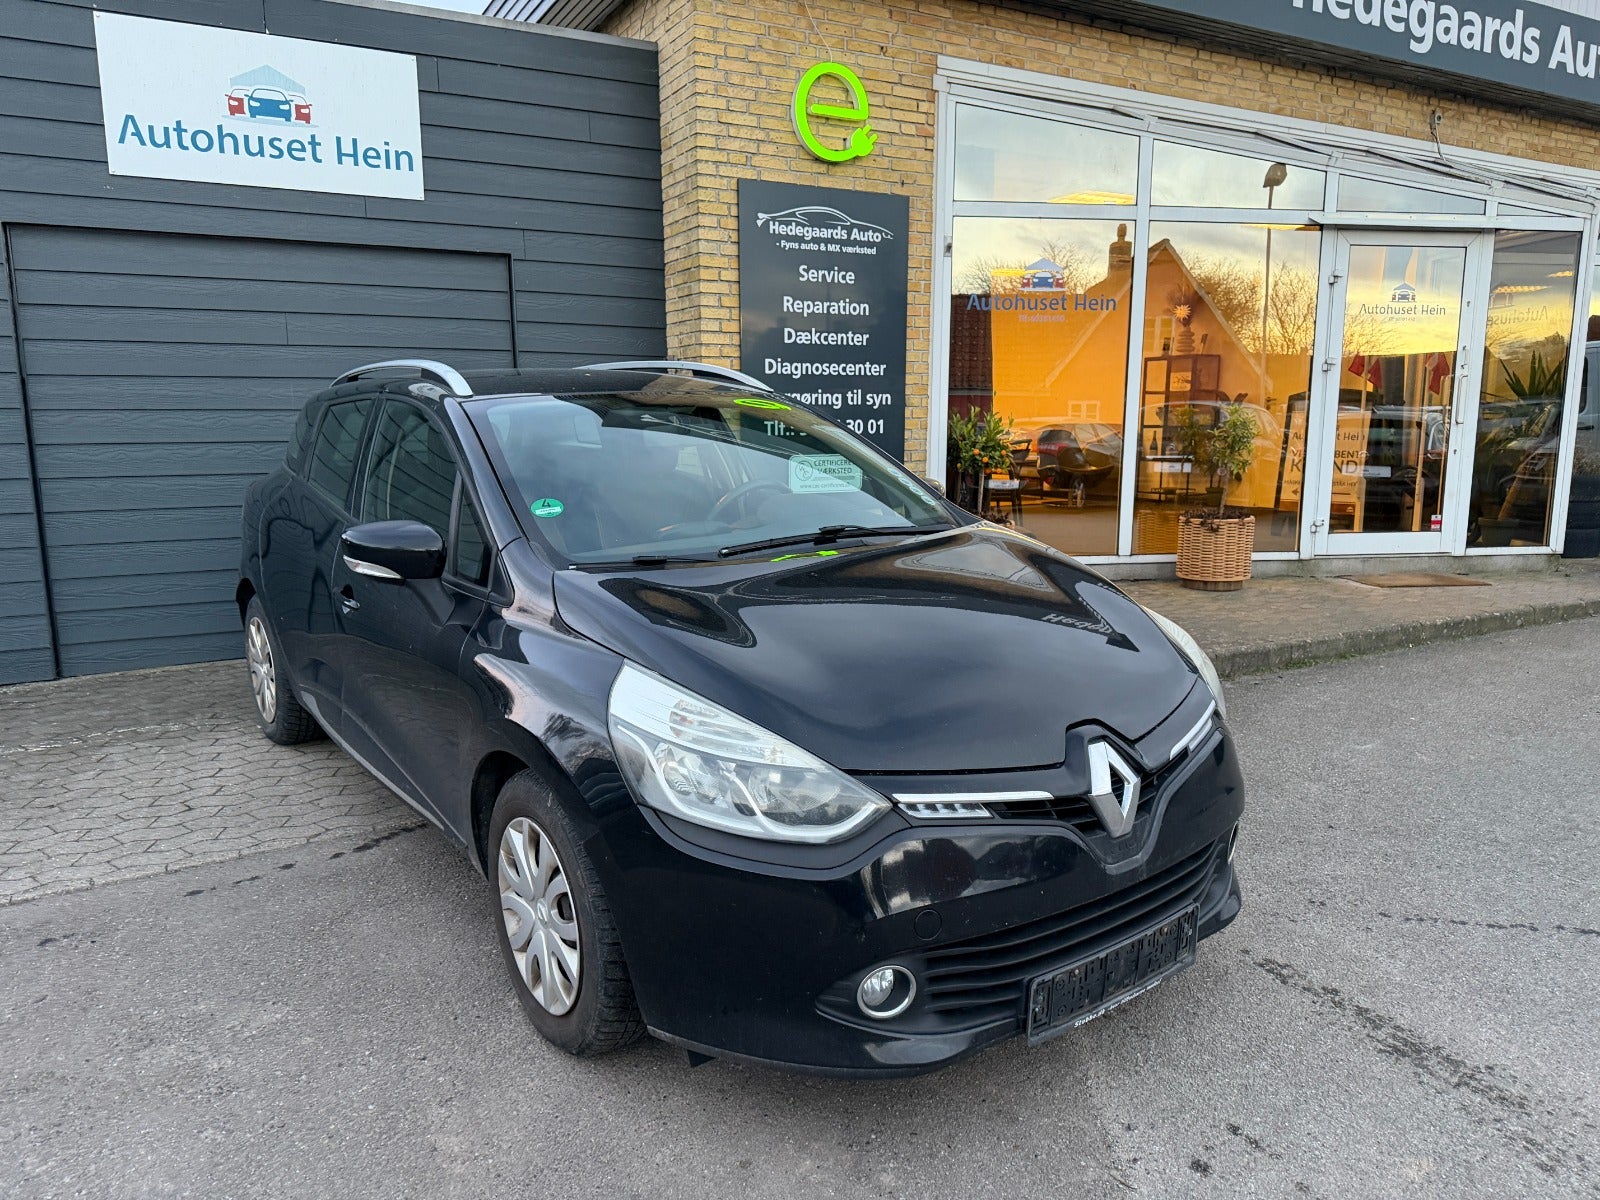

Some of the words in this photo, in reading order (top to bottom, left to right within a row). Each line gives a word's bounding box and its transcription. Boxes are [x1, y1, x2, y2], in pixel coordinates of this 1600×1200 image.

[1292, 0, 1541, 64] edegaards
[1548, 24, 1600, 79] Au
[118, 113, 323, 164] Autohuset
[335, 135, 415, 172] Hein
[769, 220, 848, 241] Hedegaards
[850, 228, 882, 243] Auto
[780, 240, 799, 250] Fyns
[800, 241, 819, 251] auto
[819, 242, 827, 251] &
[827, 244, 841, 253] MX
[841, 245, 877, 255] værksted
[798, 264, 856, 285] Service
[782, 295, 870, 318] Reparation
[966, 293, 1068, 312] Autohuset
[1074, 293, 1118, 312] Hein
[1359, 303, 1418, 316] Autohuset
[1421, 304, 1446, 316] Hein
[783, 327, 870, 346] Dækcenter
[764, 358, 887, 380] Diagnosecenter
[847, 389, 862, 405] til
[866, 392, 892, 409] syn
[867, 419, 884, 435] 01
[813, 459, 852, 467] CERTIFICERE
